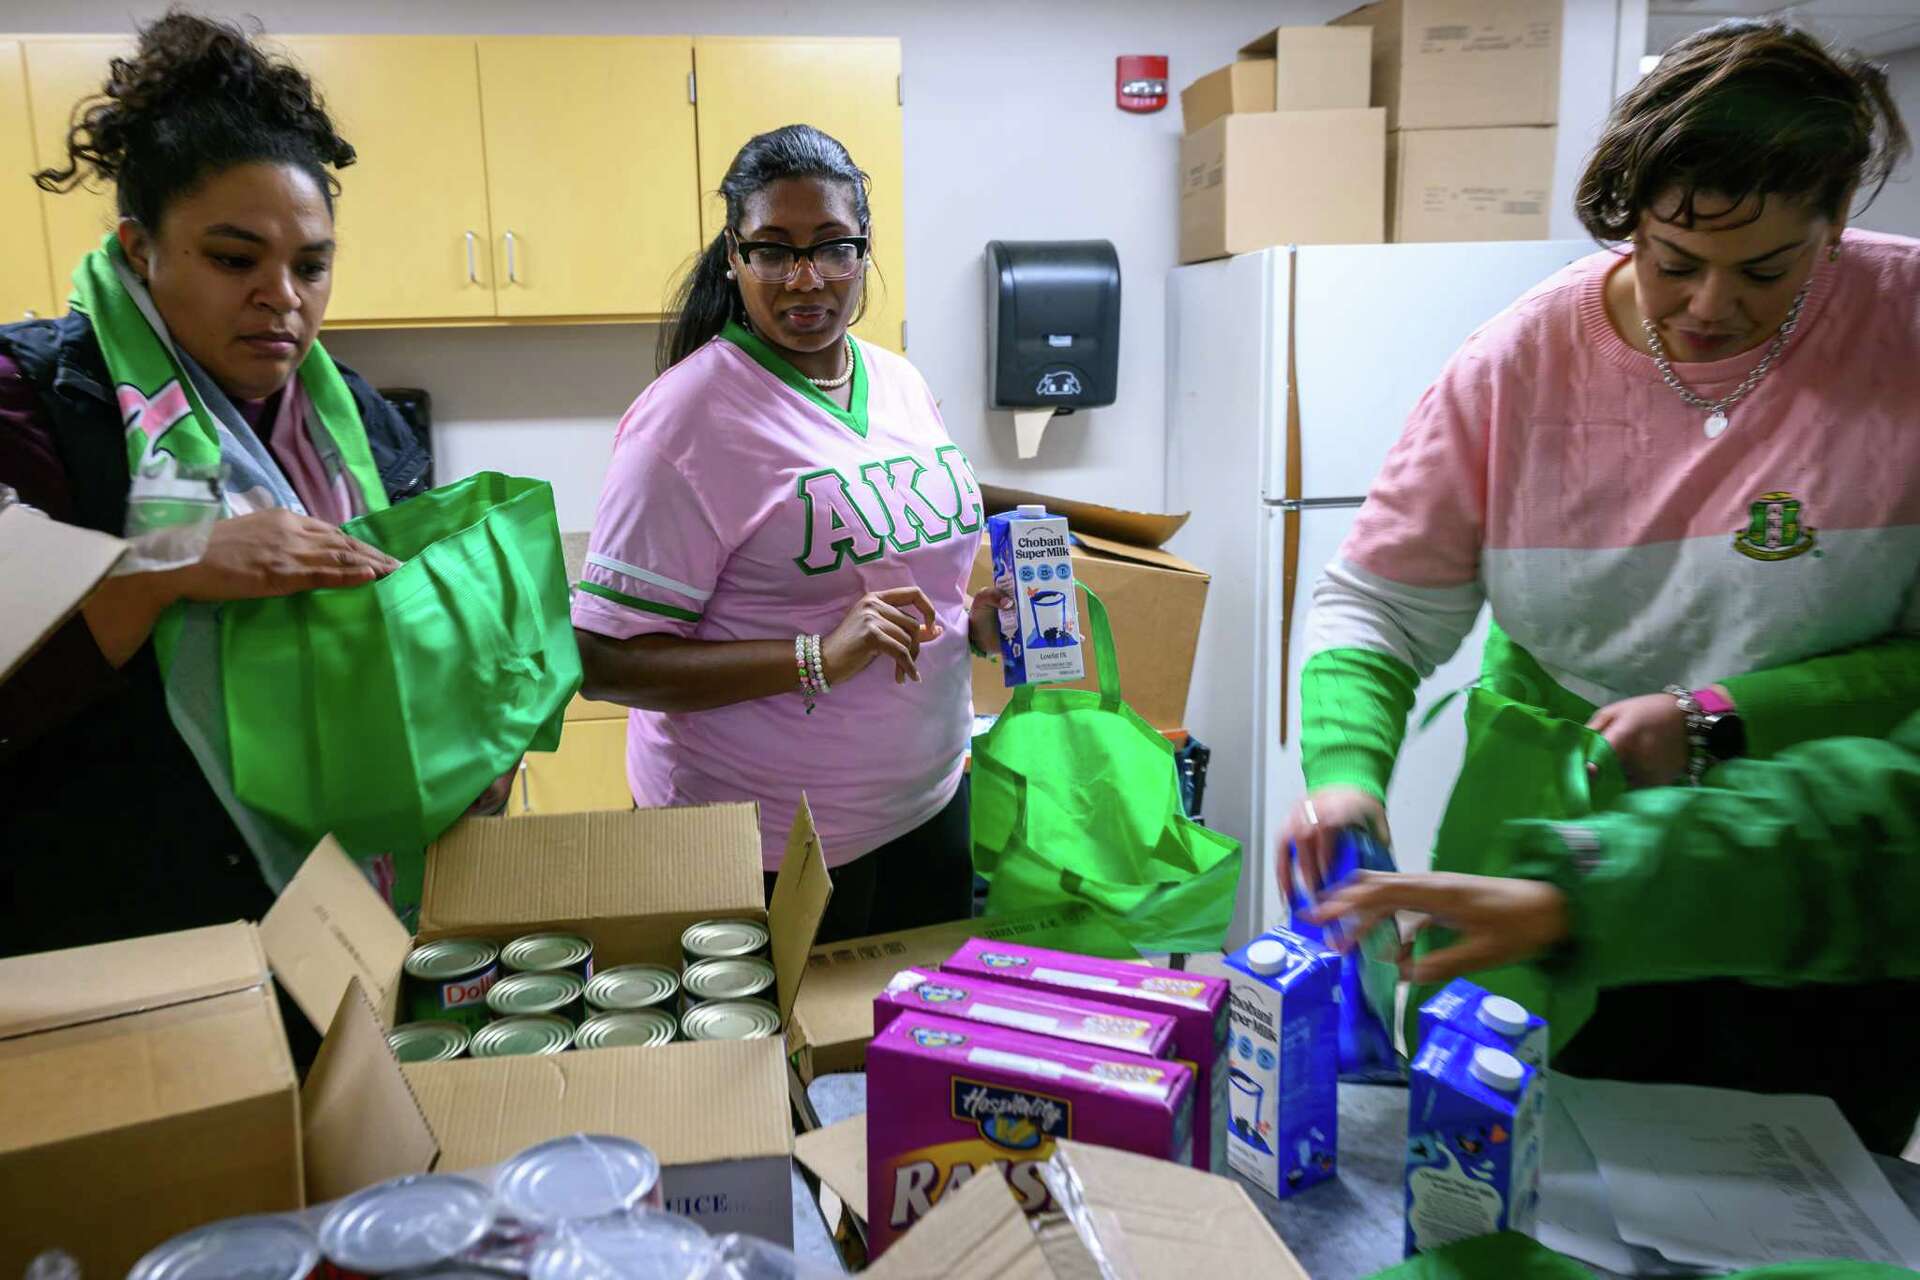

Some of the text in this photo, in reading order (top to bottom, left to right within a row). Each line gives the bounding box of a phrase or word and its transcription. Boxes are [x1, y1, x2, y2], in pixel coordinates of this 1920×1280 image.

[793, 445, 984, 576] AKA
[1015, 547, 1070, 560] Super Milk
[1018, 535, 1066, 548] Chobani
[1230, 990, 1273, 1027] hobani
[962, 1087, 1062, 1132] Hospitality
[664, 1194, 728, 1216] UICE
